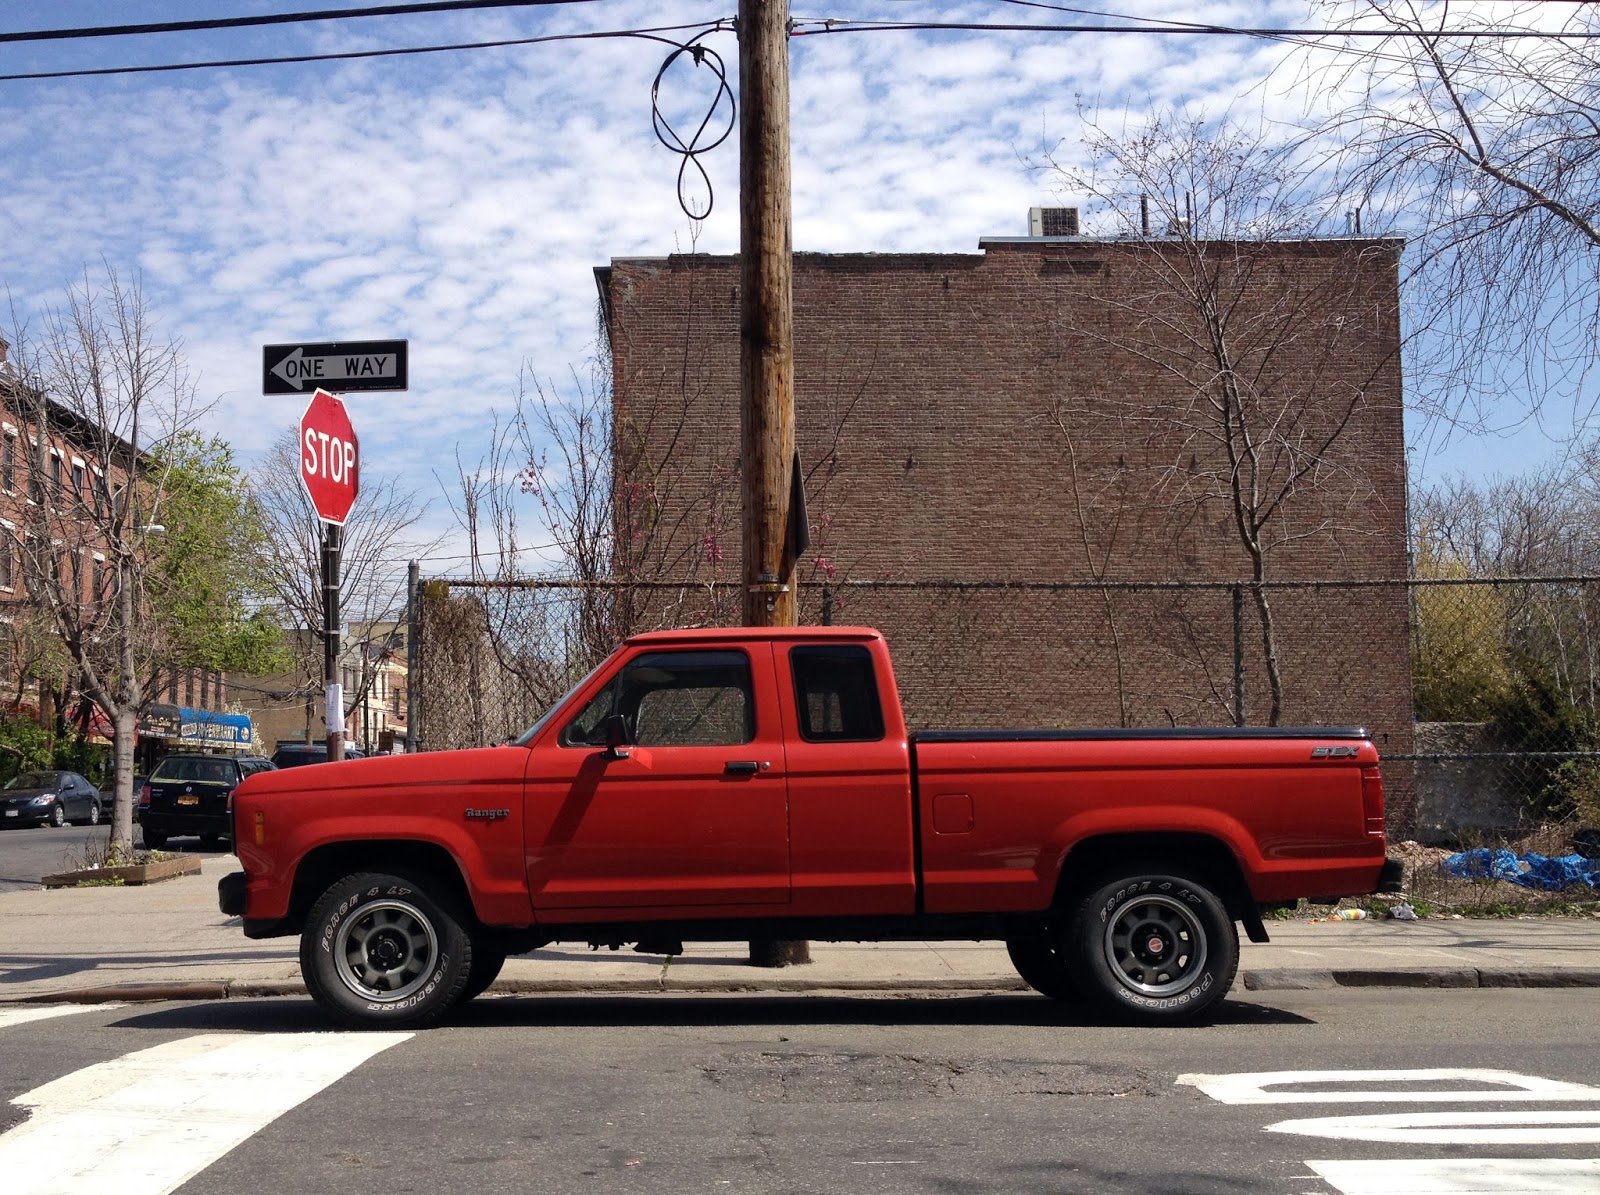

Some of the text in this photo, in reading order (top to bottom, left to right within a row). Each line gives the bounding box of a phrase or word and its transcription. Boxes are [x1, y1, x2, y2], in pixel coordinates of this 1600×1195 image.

[286, 357, 388, 378] ONE WAY
[305, 427, 356, 486] STOP
[465, 808, 510, 820] Ranger
[321, 886, 412, 952] FORCE 4 LT
[1100, 881, 1202, 922] FORCE 4 LT
[367, 952, 450, 1011] Peerless
[1118, 972, 1214, 1009] Peerless
